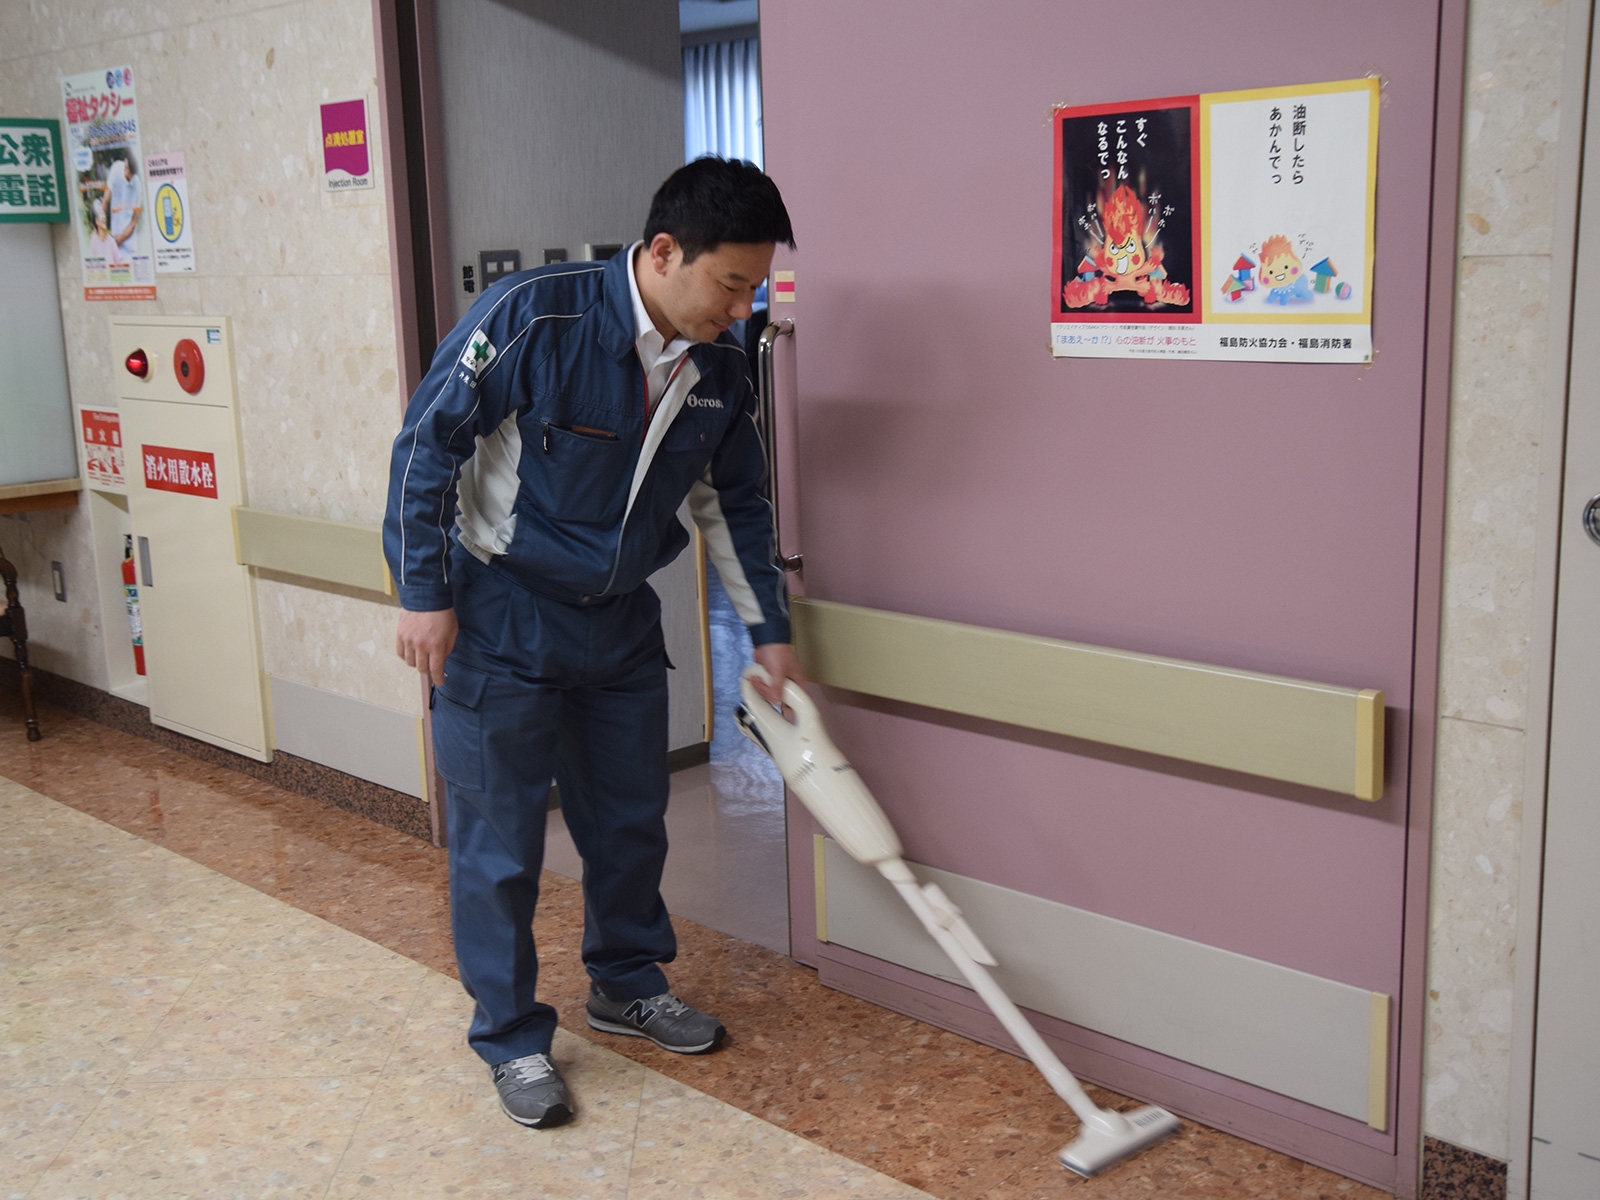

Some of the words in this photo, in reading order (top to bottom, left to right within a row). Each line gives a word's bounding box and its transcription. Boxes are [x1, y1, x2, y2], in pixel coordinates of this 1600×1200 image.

[1135, 117, 1148, 148] すぐ
[1269, 106, 1282, 185] あかんでっ
[1292, 104, 1306, 185] 油断したら
[0, 133, 51, 167] 公衆
[1097, 121, 1111, 180] なるでっ
[1116, 120, 1129, 180] こんなん
[0, 174, 57, 206] 電話
[328, 179, 351, 188] Injection
[352, 177, 368, 186] Room
[1157, 336, 1197, 346] 火事のもと
[1219, 337, 1353, 349] 福島防火協力会・福島消防署
[145, 454, 215, 488] 消火用散水栓
[622, 998, 659, 1029] N
